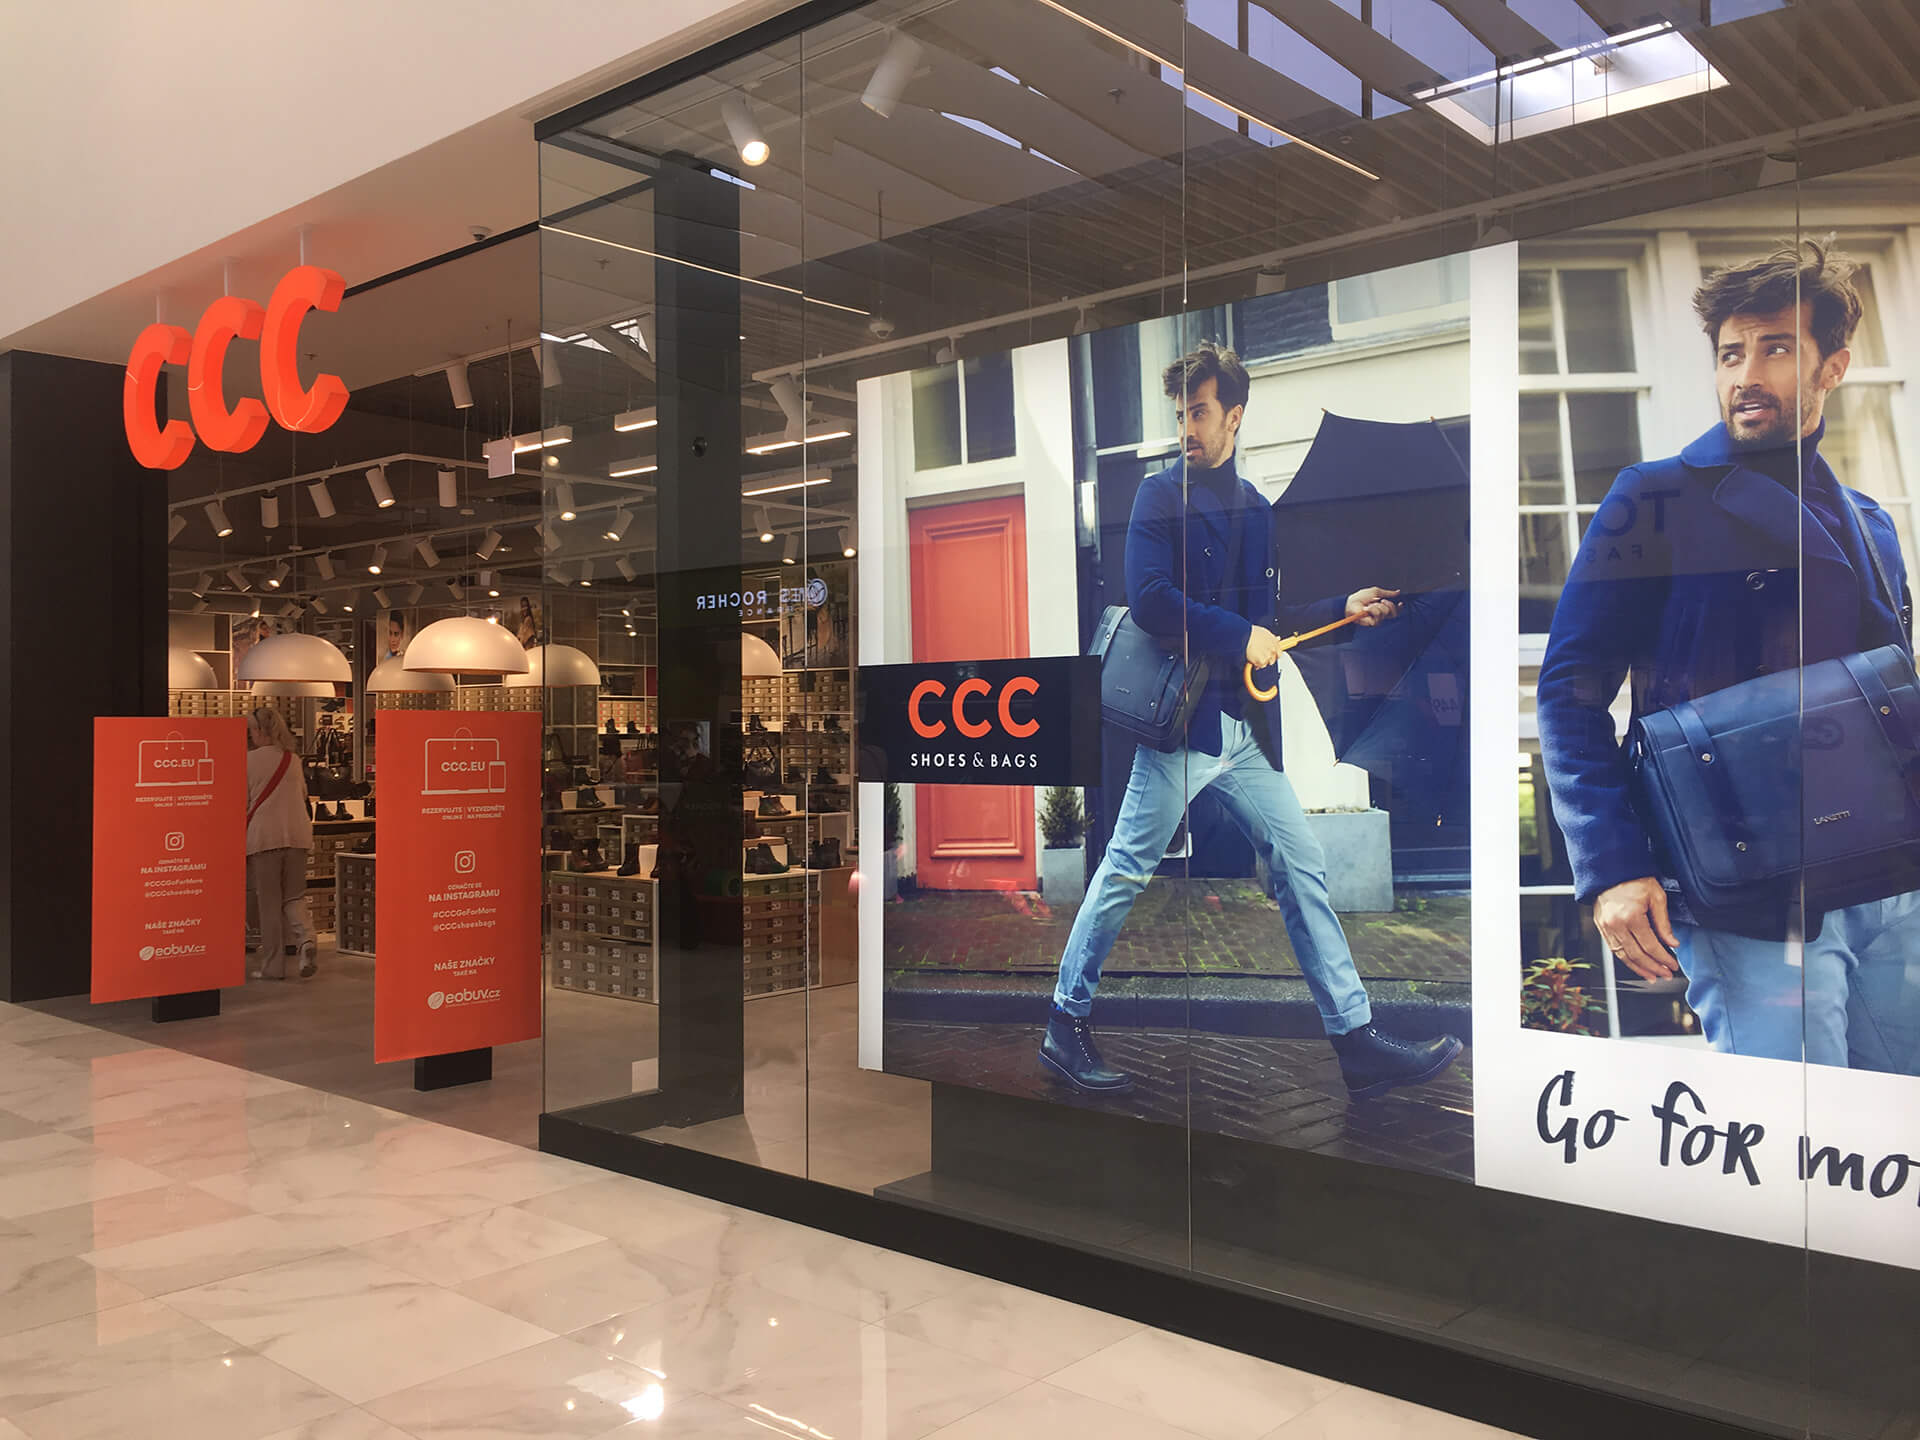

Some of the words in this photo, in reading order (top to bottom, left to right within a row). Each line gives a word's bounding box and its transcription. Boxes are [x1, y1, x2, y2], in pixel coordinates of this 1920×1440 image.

[123, 265, 350, 470] CCC
[908, 676, 1040, 738] CCC
[153, 758, 195, 769] CCC.EU
[440, 760, 486, 772] CCC.EU
[910, 752, 967, 768] SHOES
[972, 752, 985, 768] &
[990, 753, 1038, 768] BAGS
[140, 866, 153, 874] NA
[154, 863, 207, 874] INSTAGRAMU
[428, 893, 442, 902] NA
[443, 889, 500, 901] INSTAGRAMU
[144, 920, 167, 930] NAŠE
[168, 917, 202, 928] ZNAČKY
[155, 943, 206, 957] eobuv.cz
[433, 959, 458, 971] NAŠE
[459, 956, 496, 968] ZNAČKY
[445, 988, 501, 1004] eobuv.cz
[1536, 1069, 1631, 1164] Go
[1798, 1135, 1920, 1208] mo
